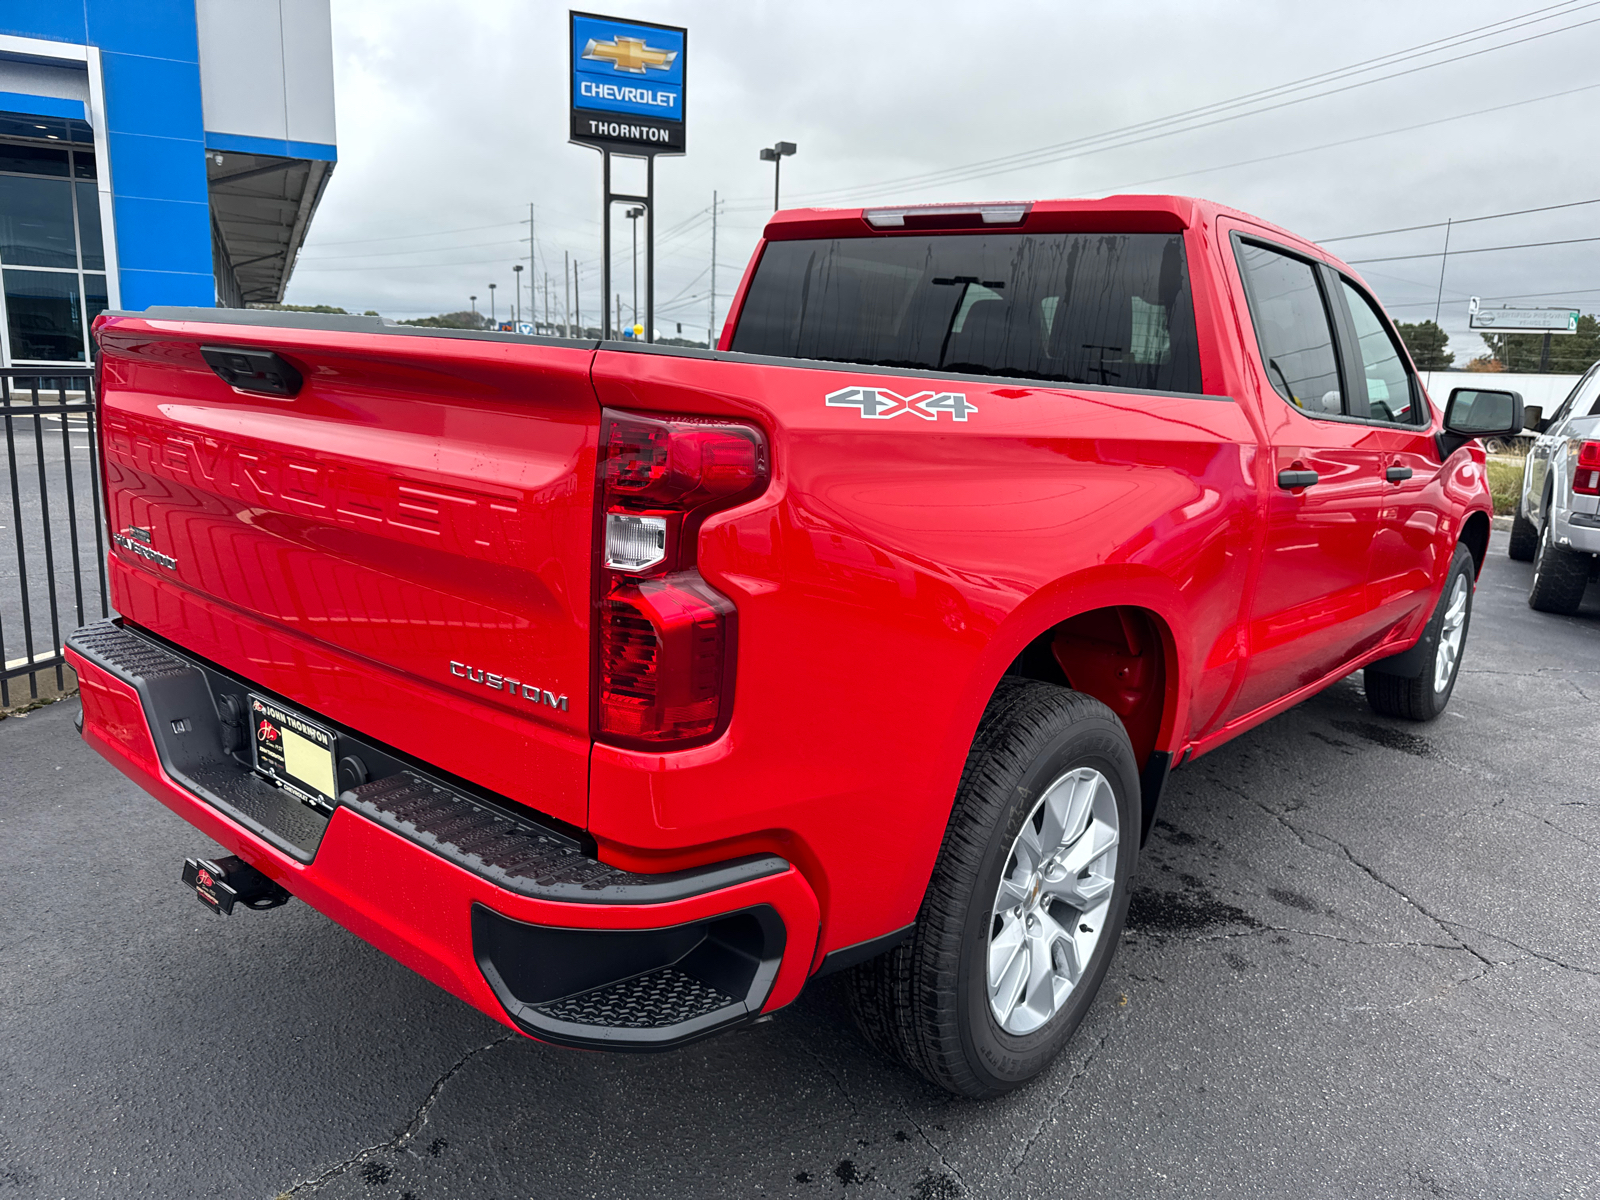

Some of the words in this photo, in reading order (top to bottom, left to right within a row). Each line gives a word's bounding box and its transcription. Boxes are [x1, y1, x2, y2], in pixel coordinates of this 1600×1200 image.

[580, 81, 677, 107] CHEVROLET
[589, 120, 669, 142] THORNTON
[104, 414, 519, 547] CHEVROLET
[450, 660, 569, 711] CUSTOM
[267, 706, 287, 724] JOHN
[287, 716, 328, 745] THORNTON
[283, 784, 308, 802] CHEVROLET
